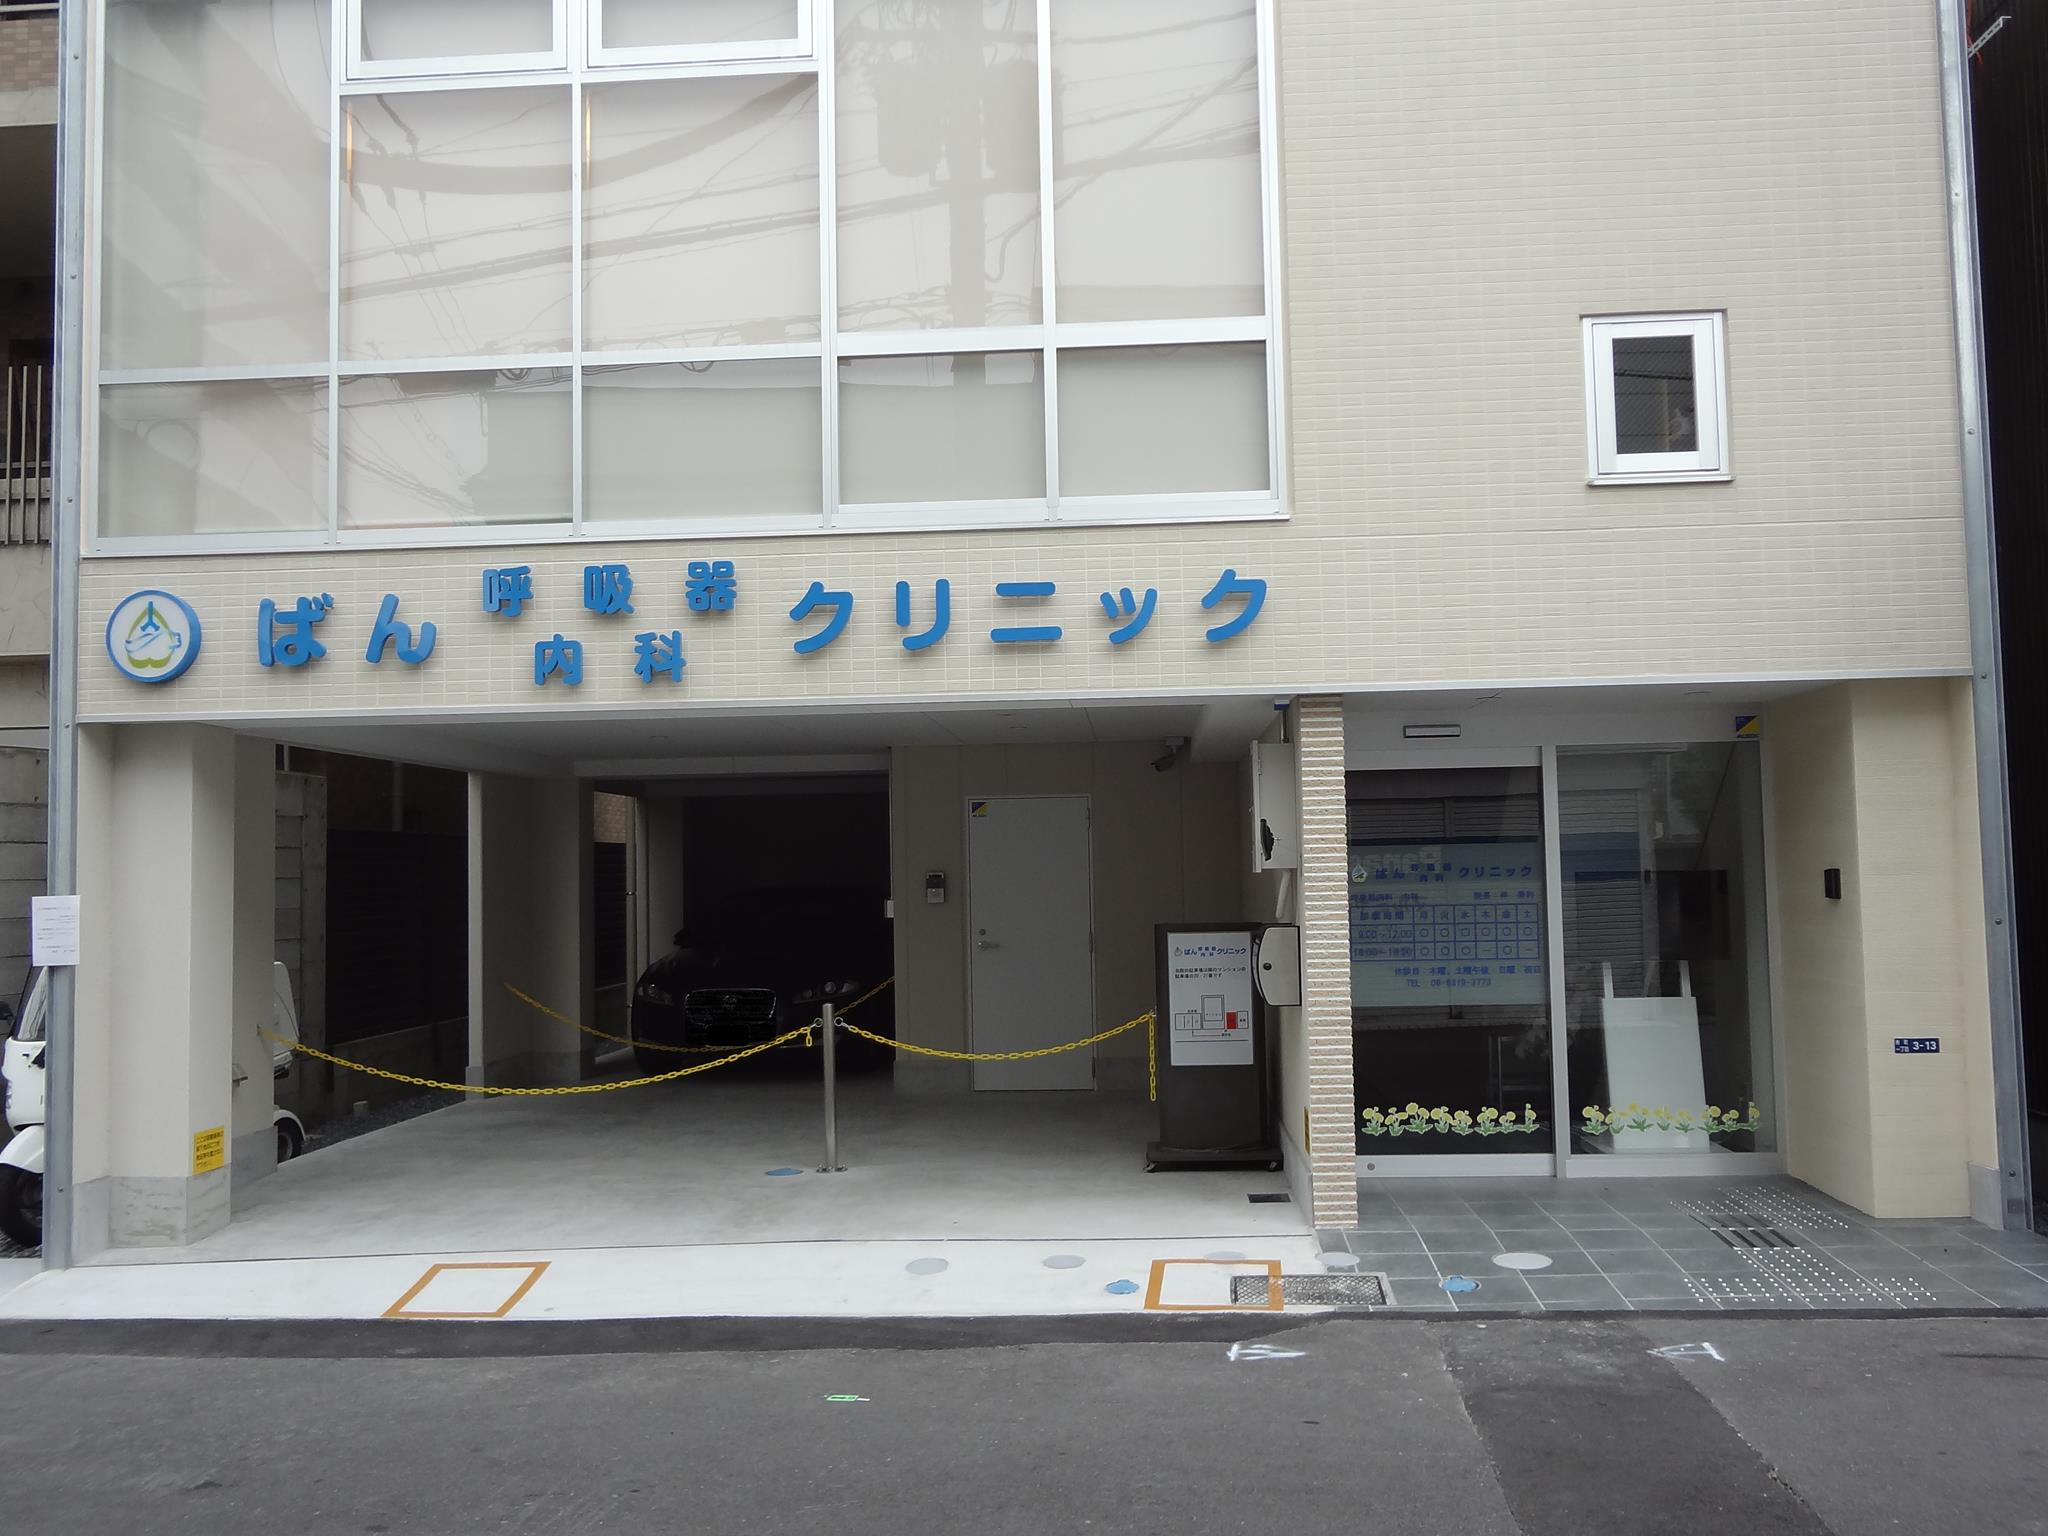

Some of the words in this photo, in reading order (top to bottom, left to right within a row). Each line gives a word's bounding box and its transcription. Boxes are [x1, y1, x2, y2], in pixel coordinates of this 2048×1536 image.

[482, 560, 738, 618] 呼吸器
[789, 569, 1269, 656] クリニック
[257, 592, 436, 668] ばん
[534, 631, 687, 687] 内科
[1458, 864, 1533, 879] クリニック
[1912, 1041, 1937, 1050] 3-13
